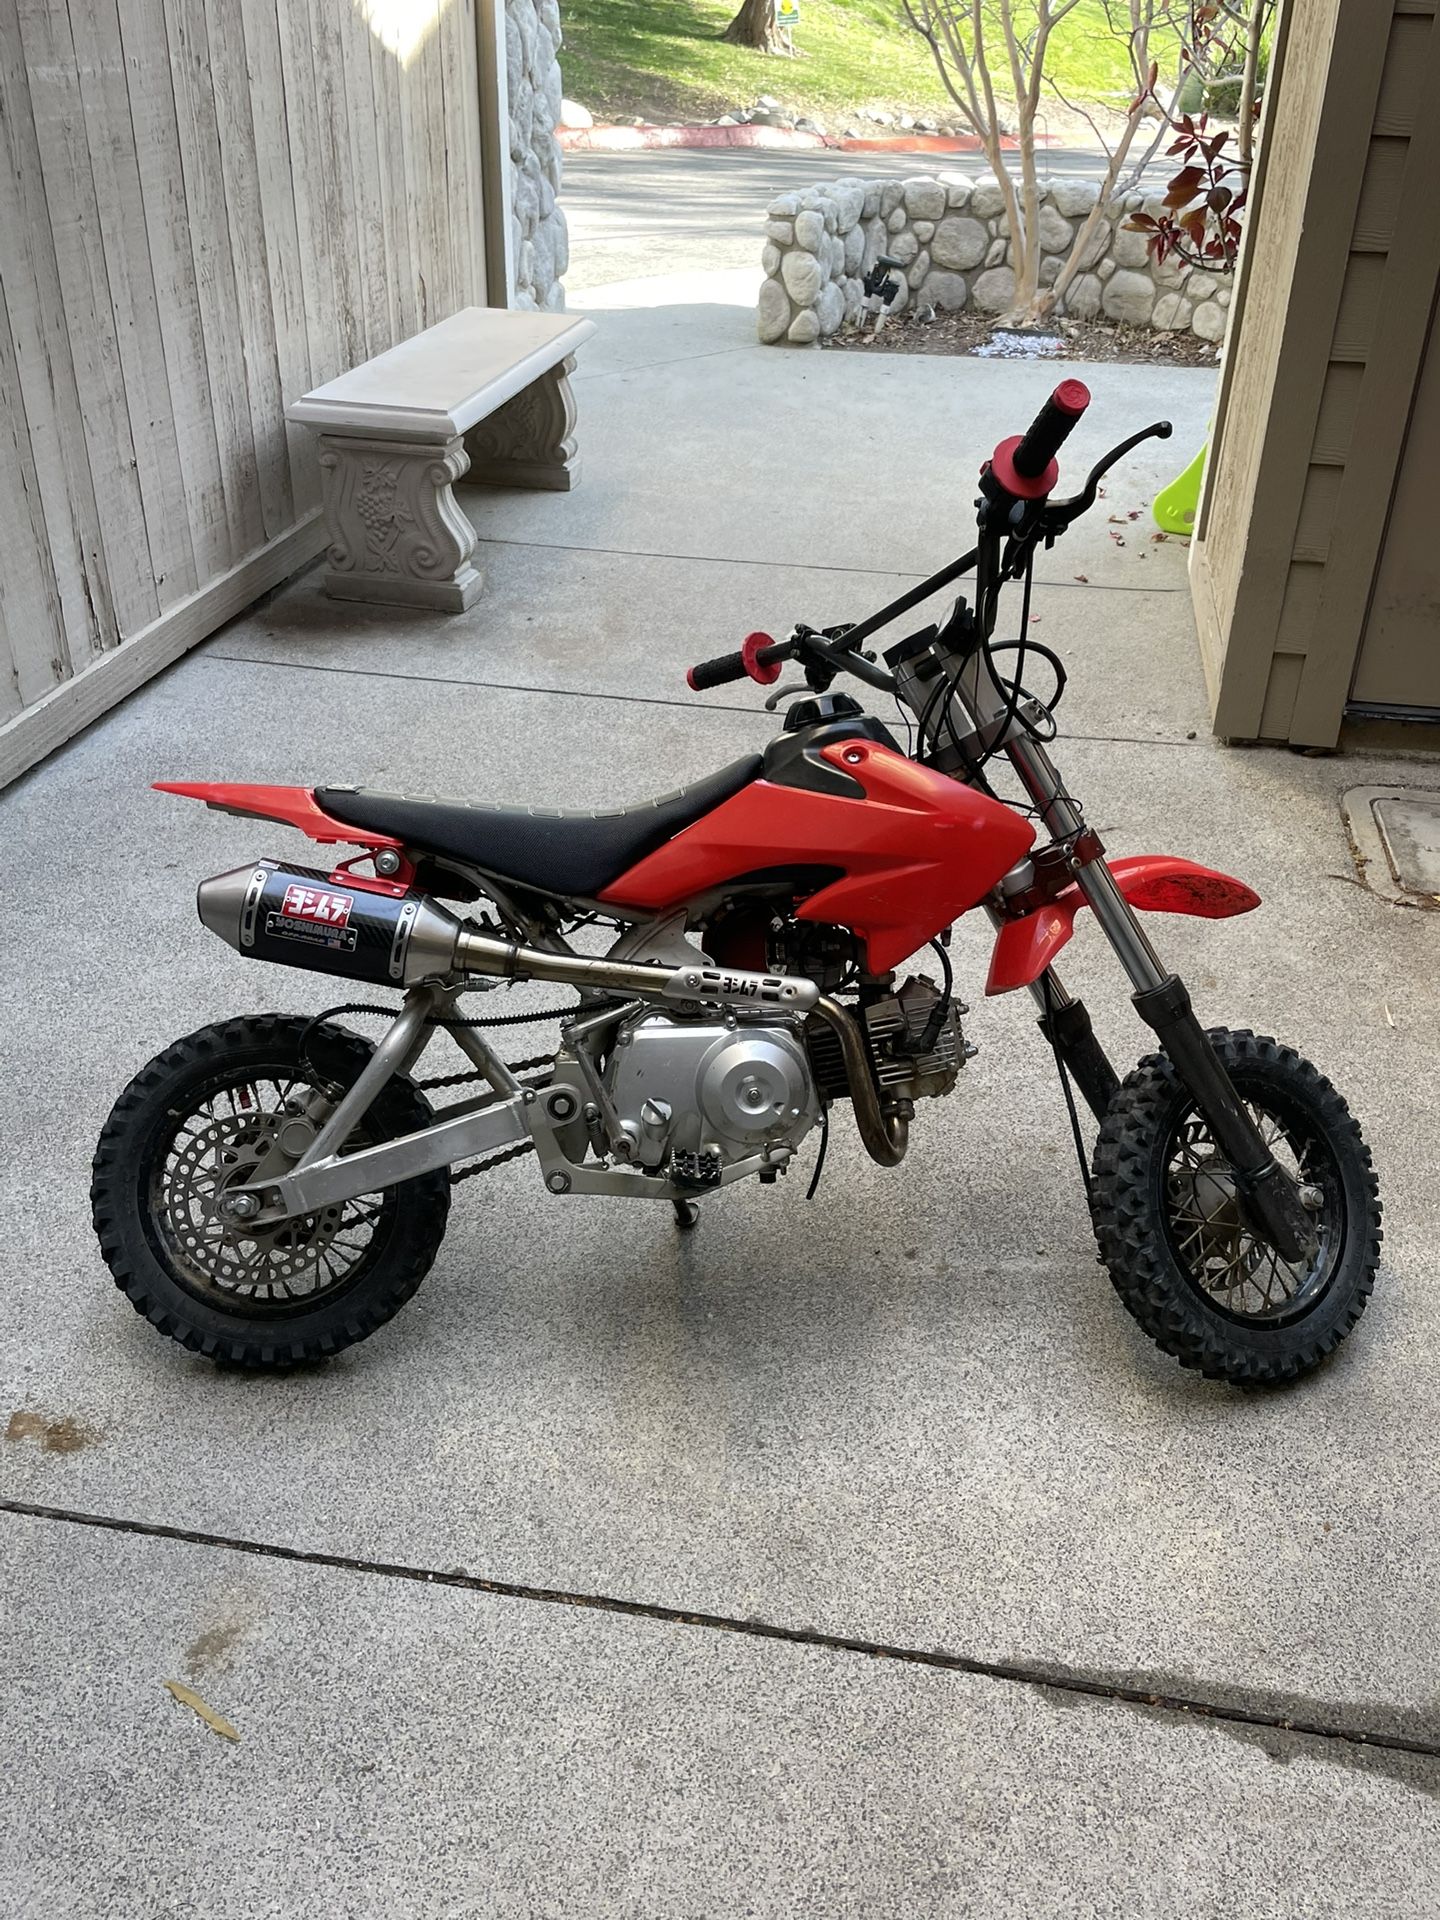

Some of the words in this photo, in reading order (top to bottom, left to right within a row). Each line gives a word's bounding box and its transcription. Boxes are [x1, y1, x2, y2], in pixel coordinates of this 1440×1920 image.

[288, 888, 347, 922] ヨシムラ
[275, 916, 348, 941] YOSHIMURA
